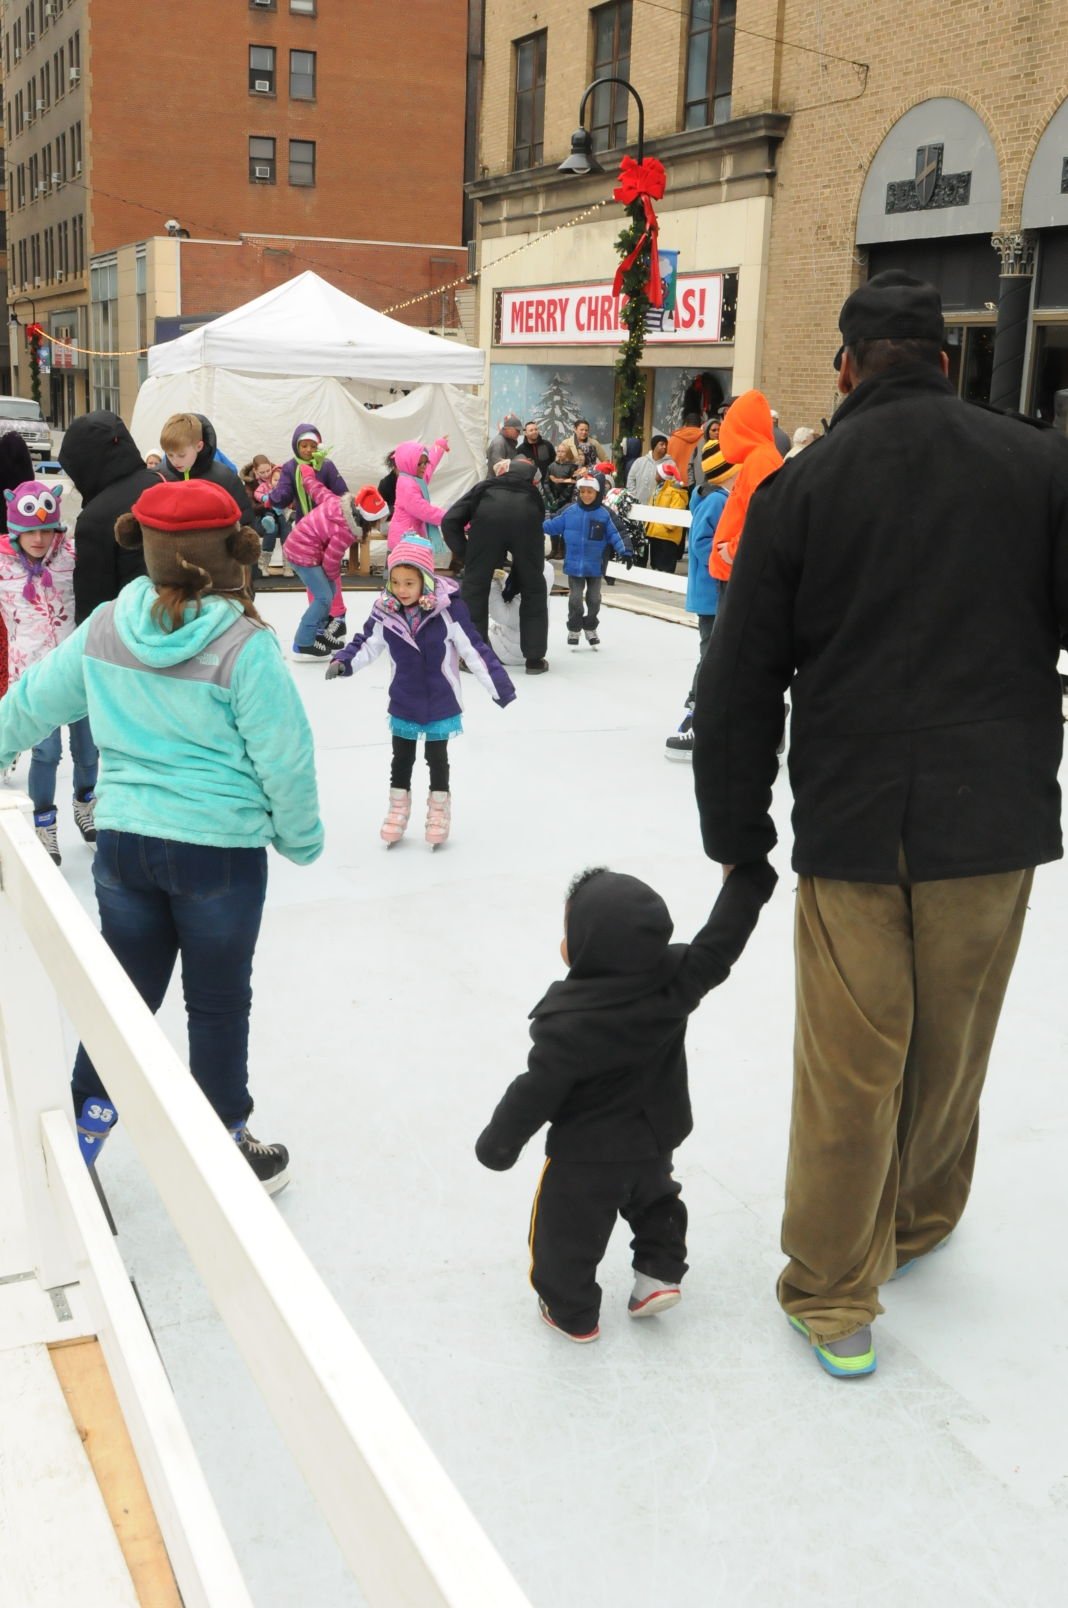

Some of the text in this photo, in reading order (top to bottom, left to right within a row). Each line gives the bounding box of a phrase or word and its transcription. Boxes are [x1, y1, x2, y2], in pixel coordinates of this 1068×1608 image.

[511, 288, 706, 333] MERRY CHRISS!
[88, 1104, 114, 1122] 35
